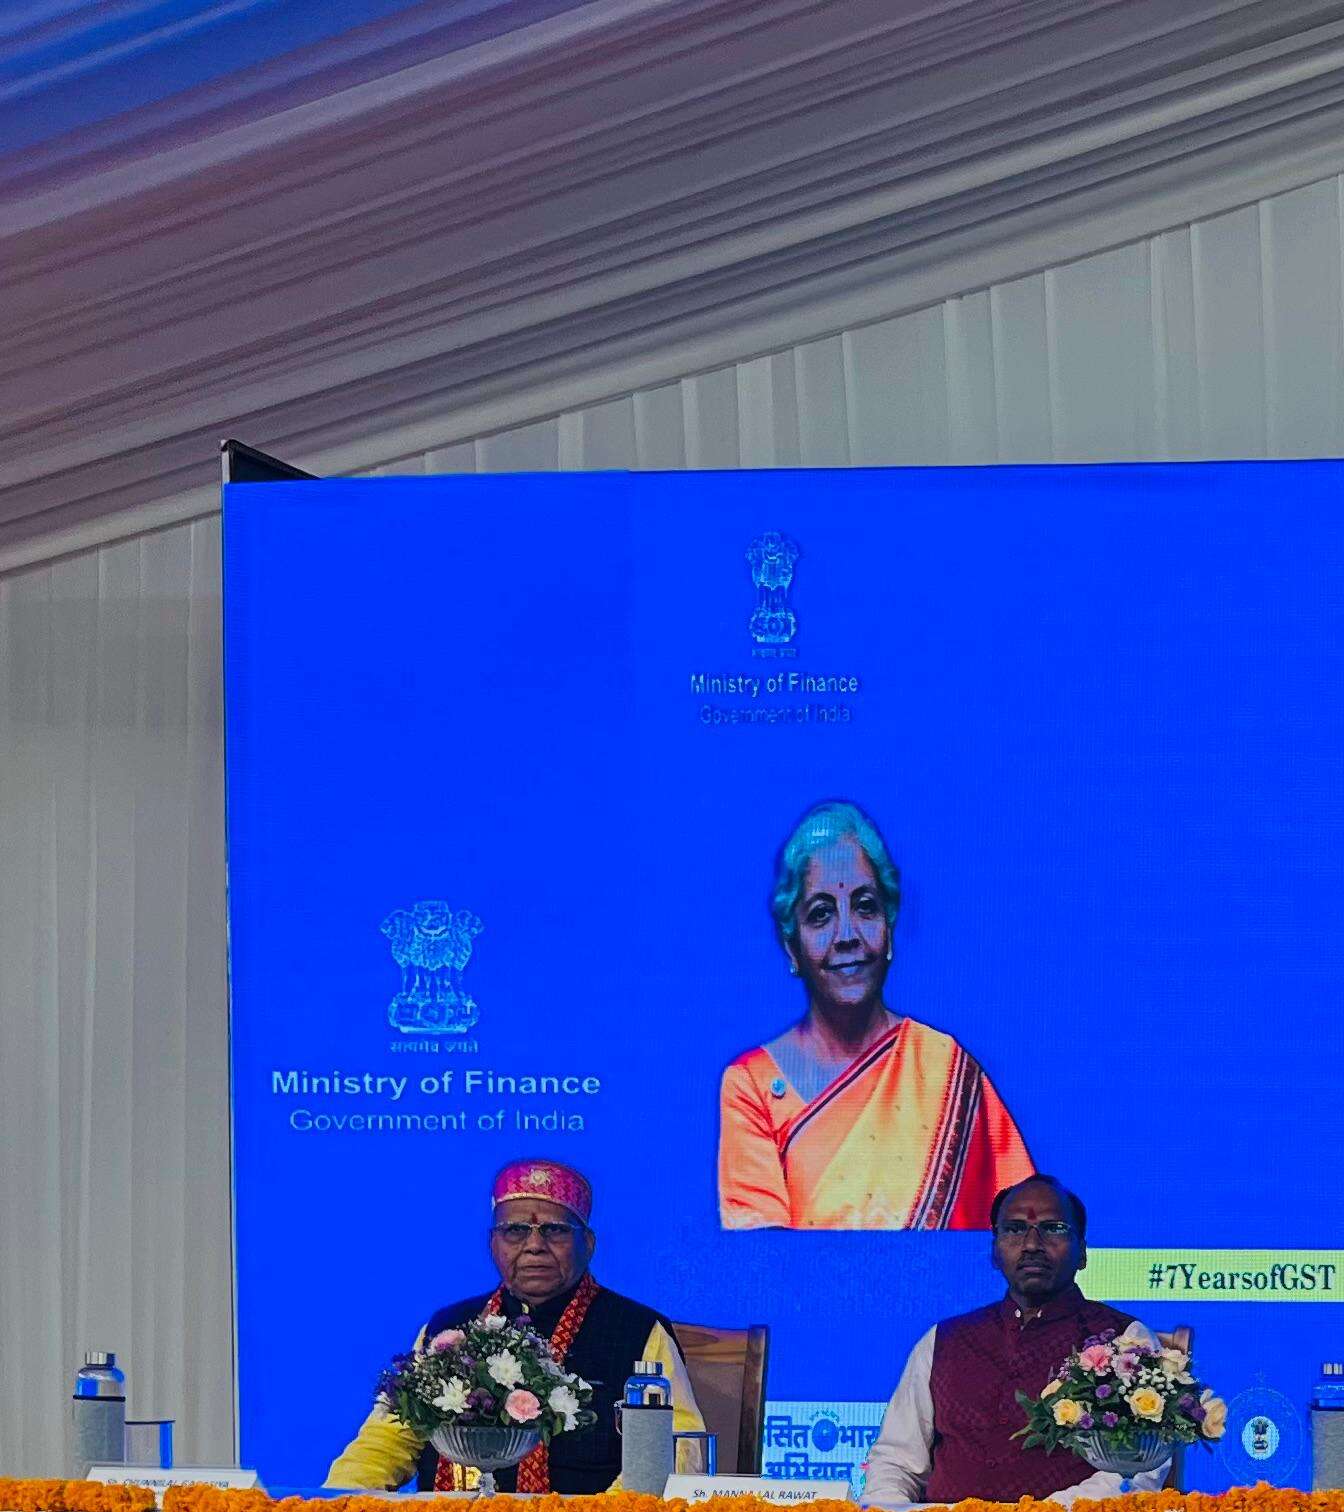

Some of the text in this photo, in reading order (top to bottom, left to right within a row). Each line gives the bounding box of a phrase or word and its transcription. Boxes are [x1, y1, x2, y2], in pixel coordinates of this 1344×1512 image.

[691, 672, 858, 698] Ministry of Finance
[271, 1070, 602, 1102] Ministry of Finance
[289, 1108, 585, 1132] Government of India
[1147, 1262, 1337, 1293] #7YearsofGST
